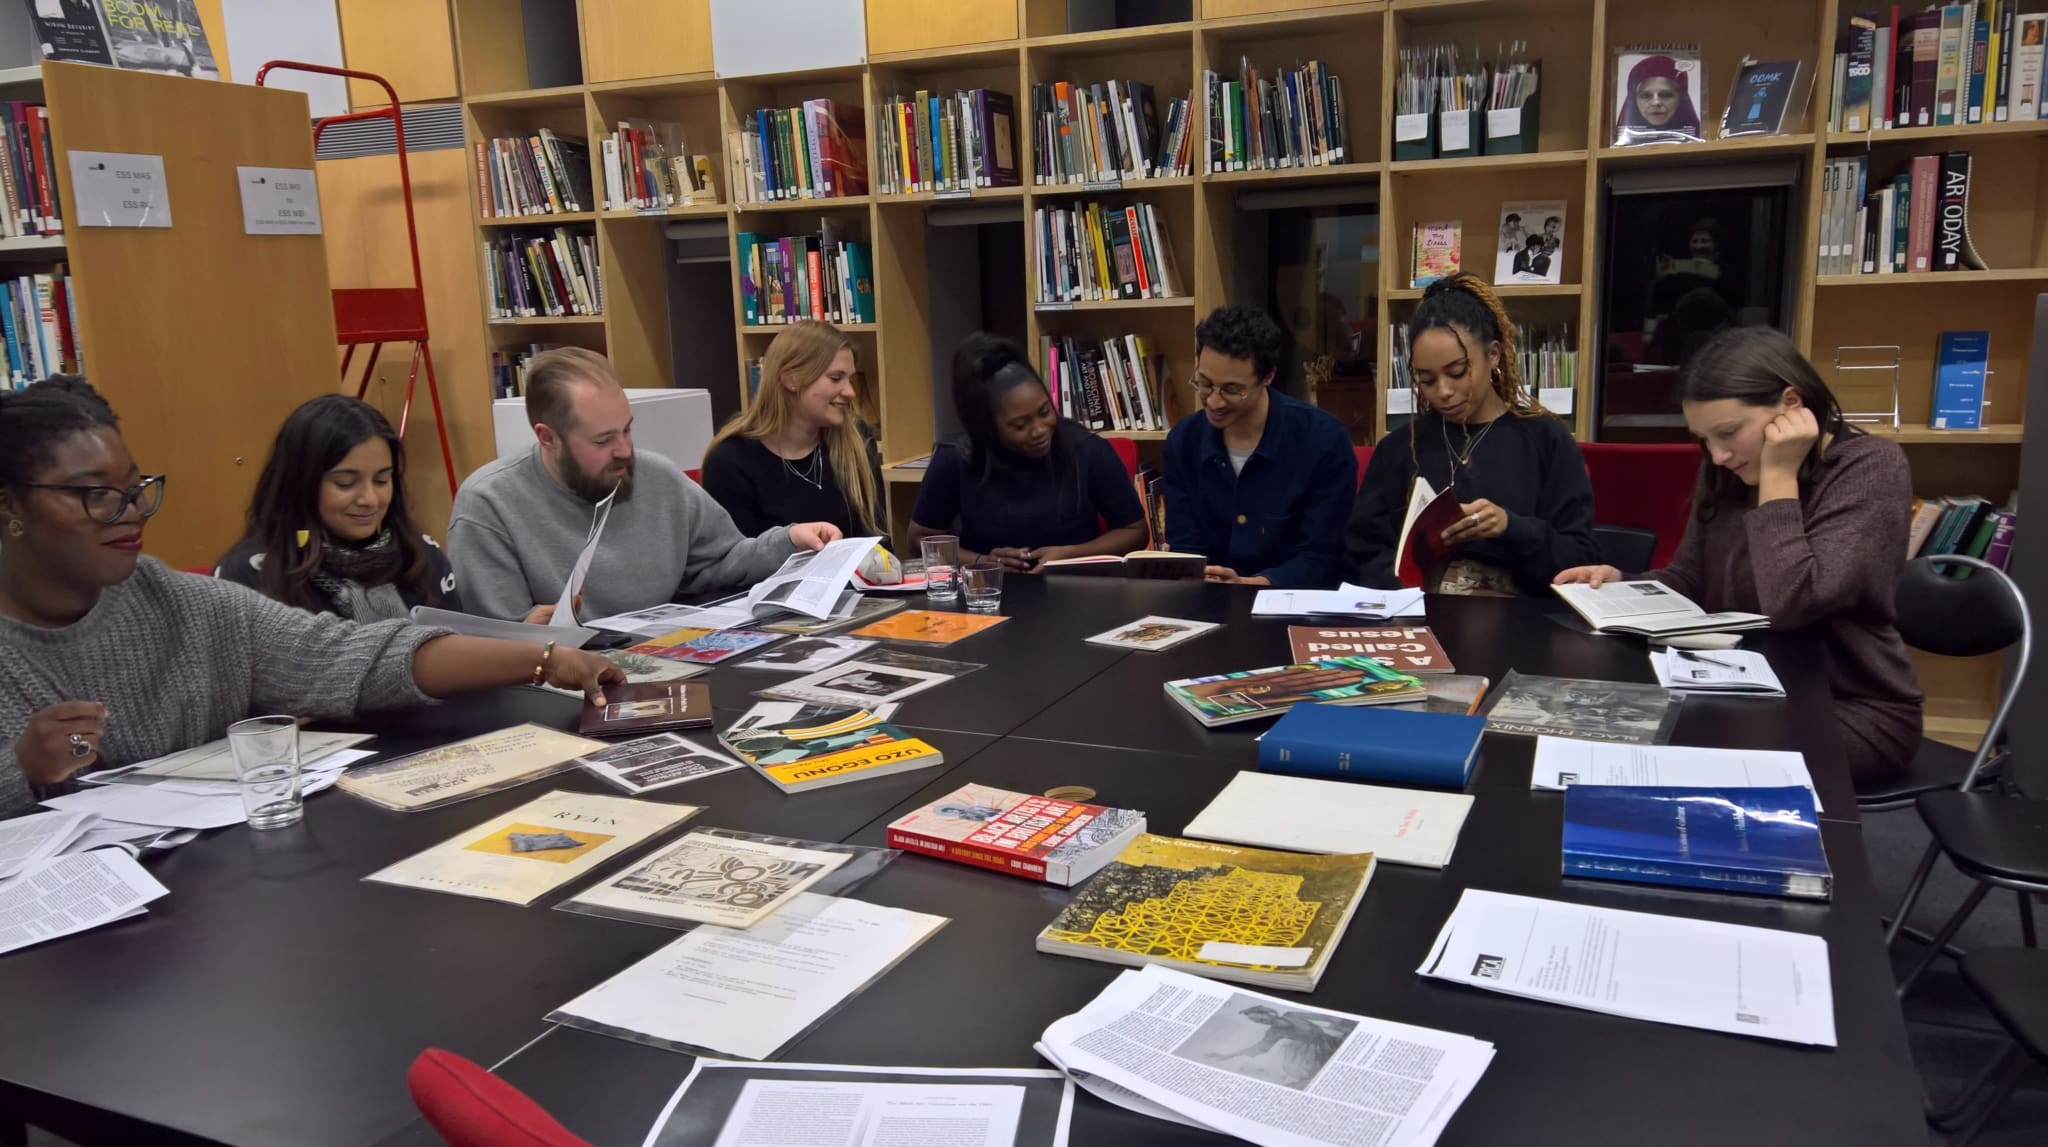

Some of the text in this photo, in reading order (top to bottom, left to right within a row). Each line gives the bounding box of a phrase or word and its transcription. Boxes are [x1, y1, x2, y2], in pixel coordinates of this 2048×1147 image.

[103, 0, 164, 17] BOOM
[108, 14, 201, 37] FOR REAL
[1086, 361, 1103, 415] ABORIGINAL
[1318, 628, 1417, 640] Jesus
[1308, 642, 1427, 653] Called
[1405, 656, 1433, 666] A
[1490, 721, 1642, 742] BLACK PHOENIX
[793, 748, 924, 779] UZO EGONU
[970, 798, 1052, 845] BLACK ARTISTS
[992, 801, 1074, 849] IN BRITISH ART
[1150, 837, 1241, 855] The Other Story
